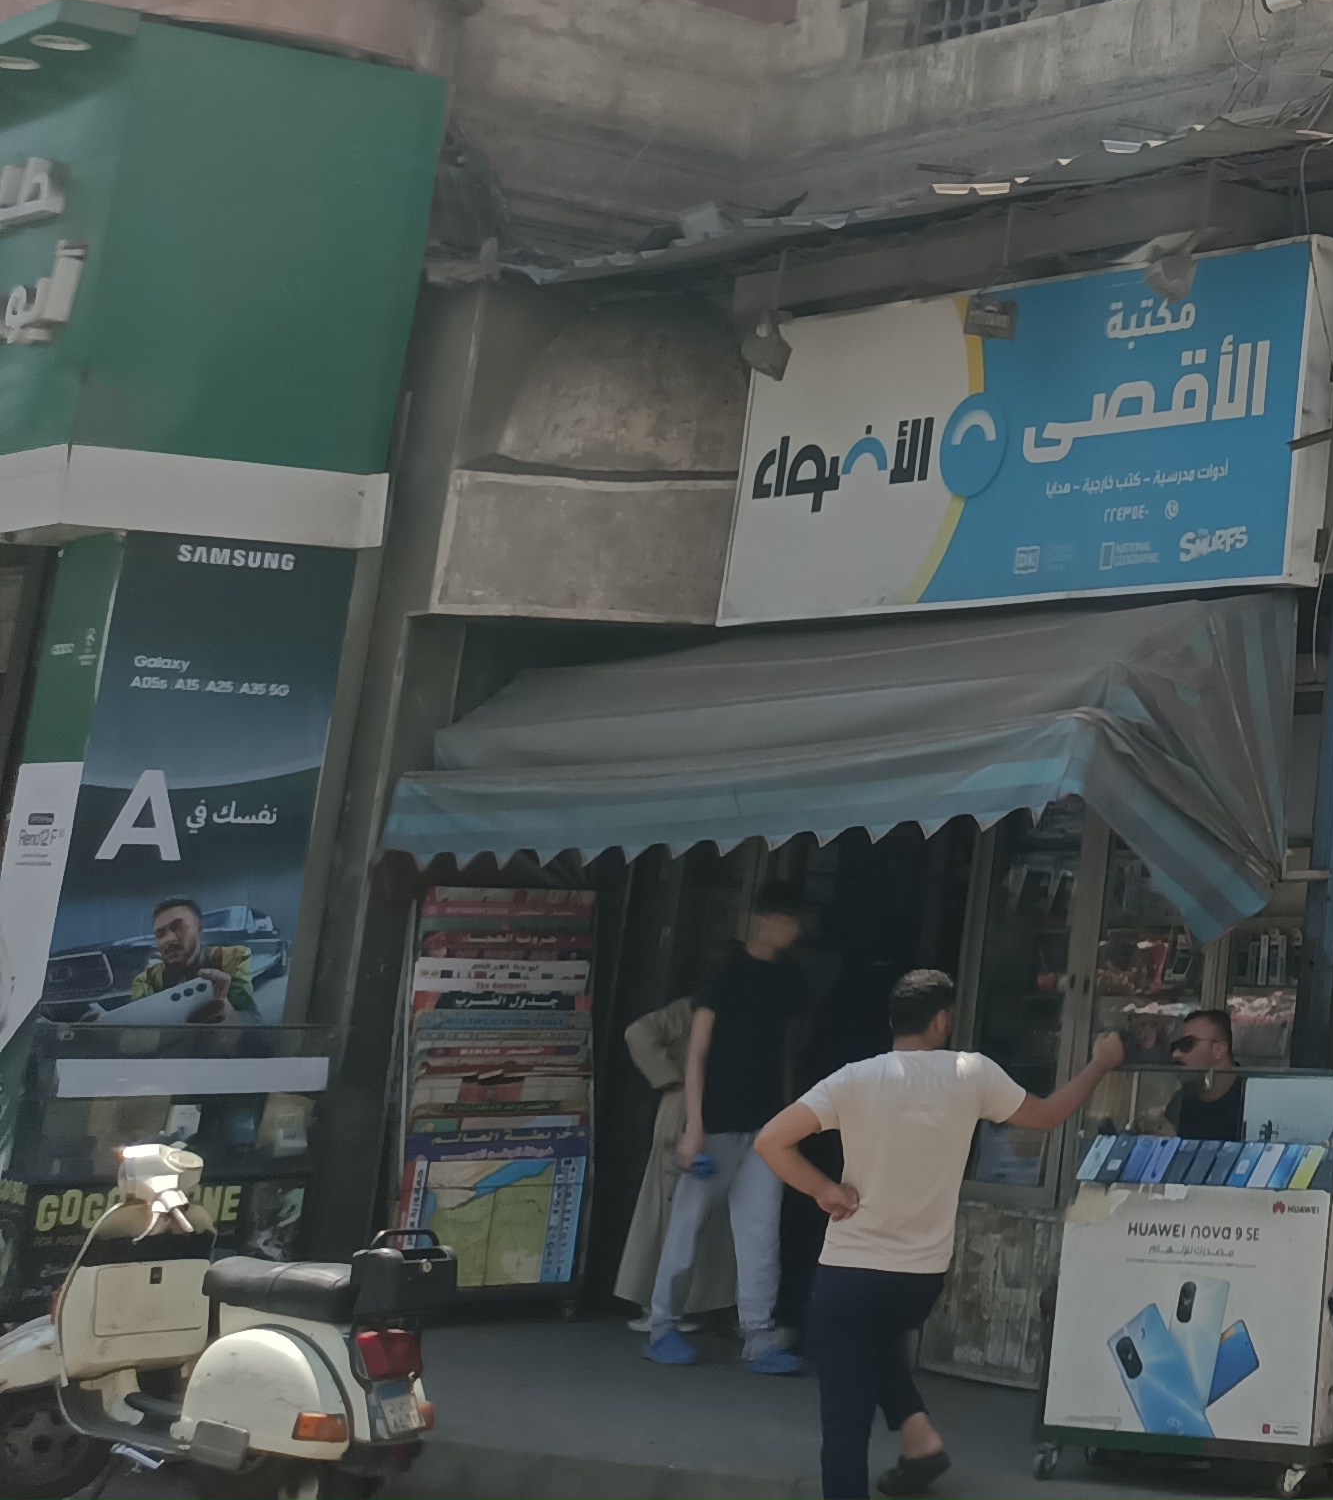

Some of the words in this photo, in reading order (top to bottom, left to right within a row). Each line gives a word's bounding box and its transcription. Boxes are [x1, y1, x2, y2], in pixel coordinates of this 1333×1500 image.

[1107, 297, 1196, 350] مكتبة
[1022, 334, 1270, 464] الأقصى
[1082, 475, 1114, 495] خارجية
[1115, 471, 1142, 492] كتب
[1153, 468, 1195, 489] مدرسية
[177, 543, 296, 572] SAMSUNG
[133, 655, 191, 673] Galaxy
[95, 770, 181, 861] A
[186, 799, 207, 835] في
[212, 800, 278, 825] نفسك
[1286, 1204, 1320, 1215] HUAWEI
[1127, 1221, 1186, 1239] HUAWEI
[1190, 1224, 1232, 1240] nova
[1235, 1226, 1243, 1241] 9
[1245, 1227, 1260, 1242] SE
